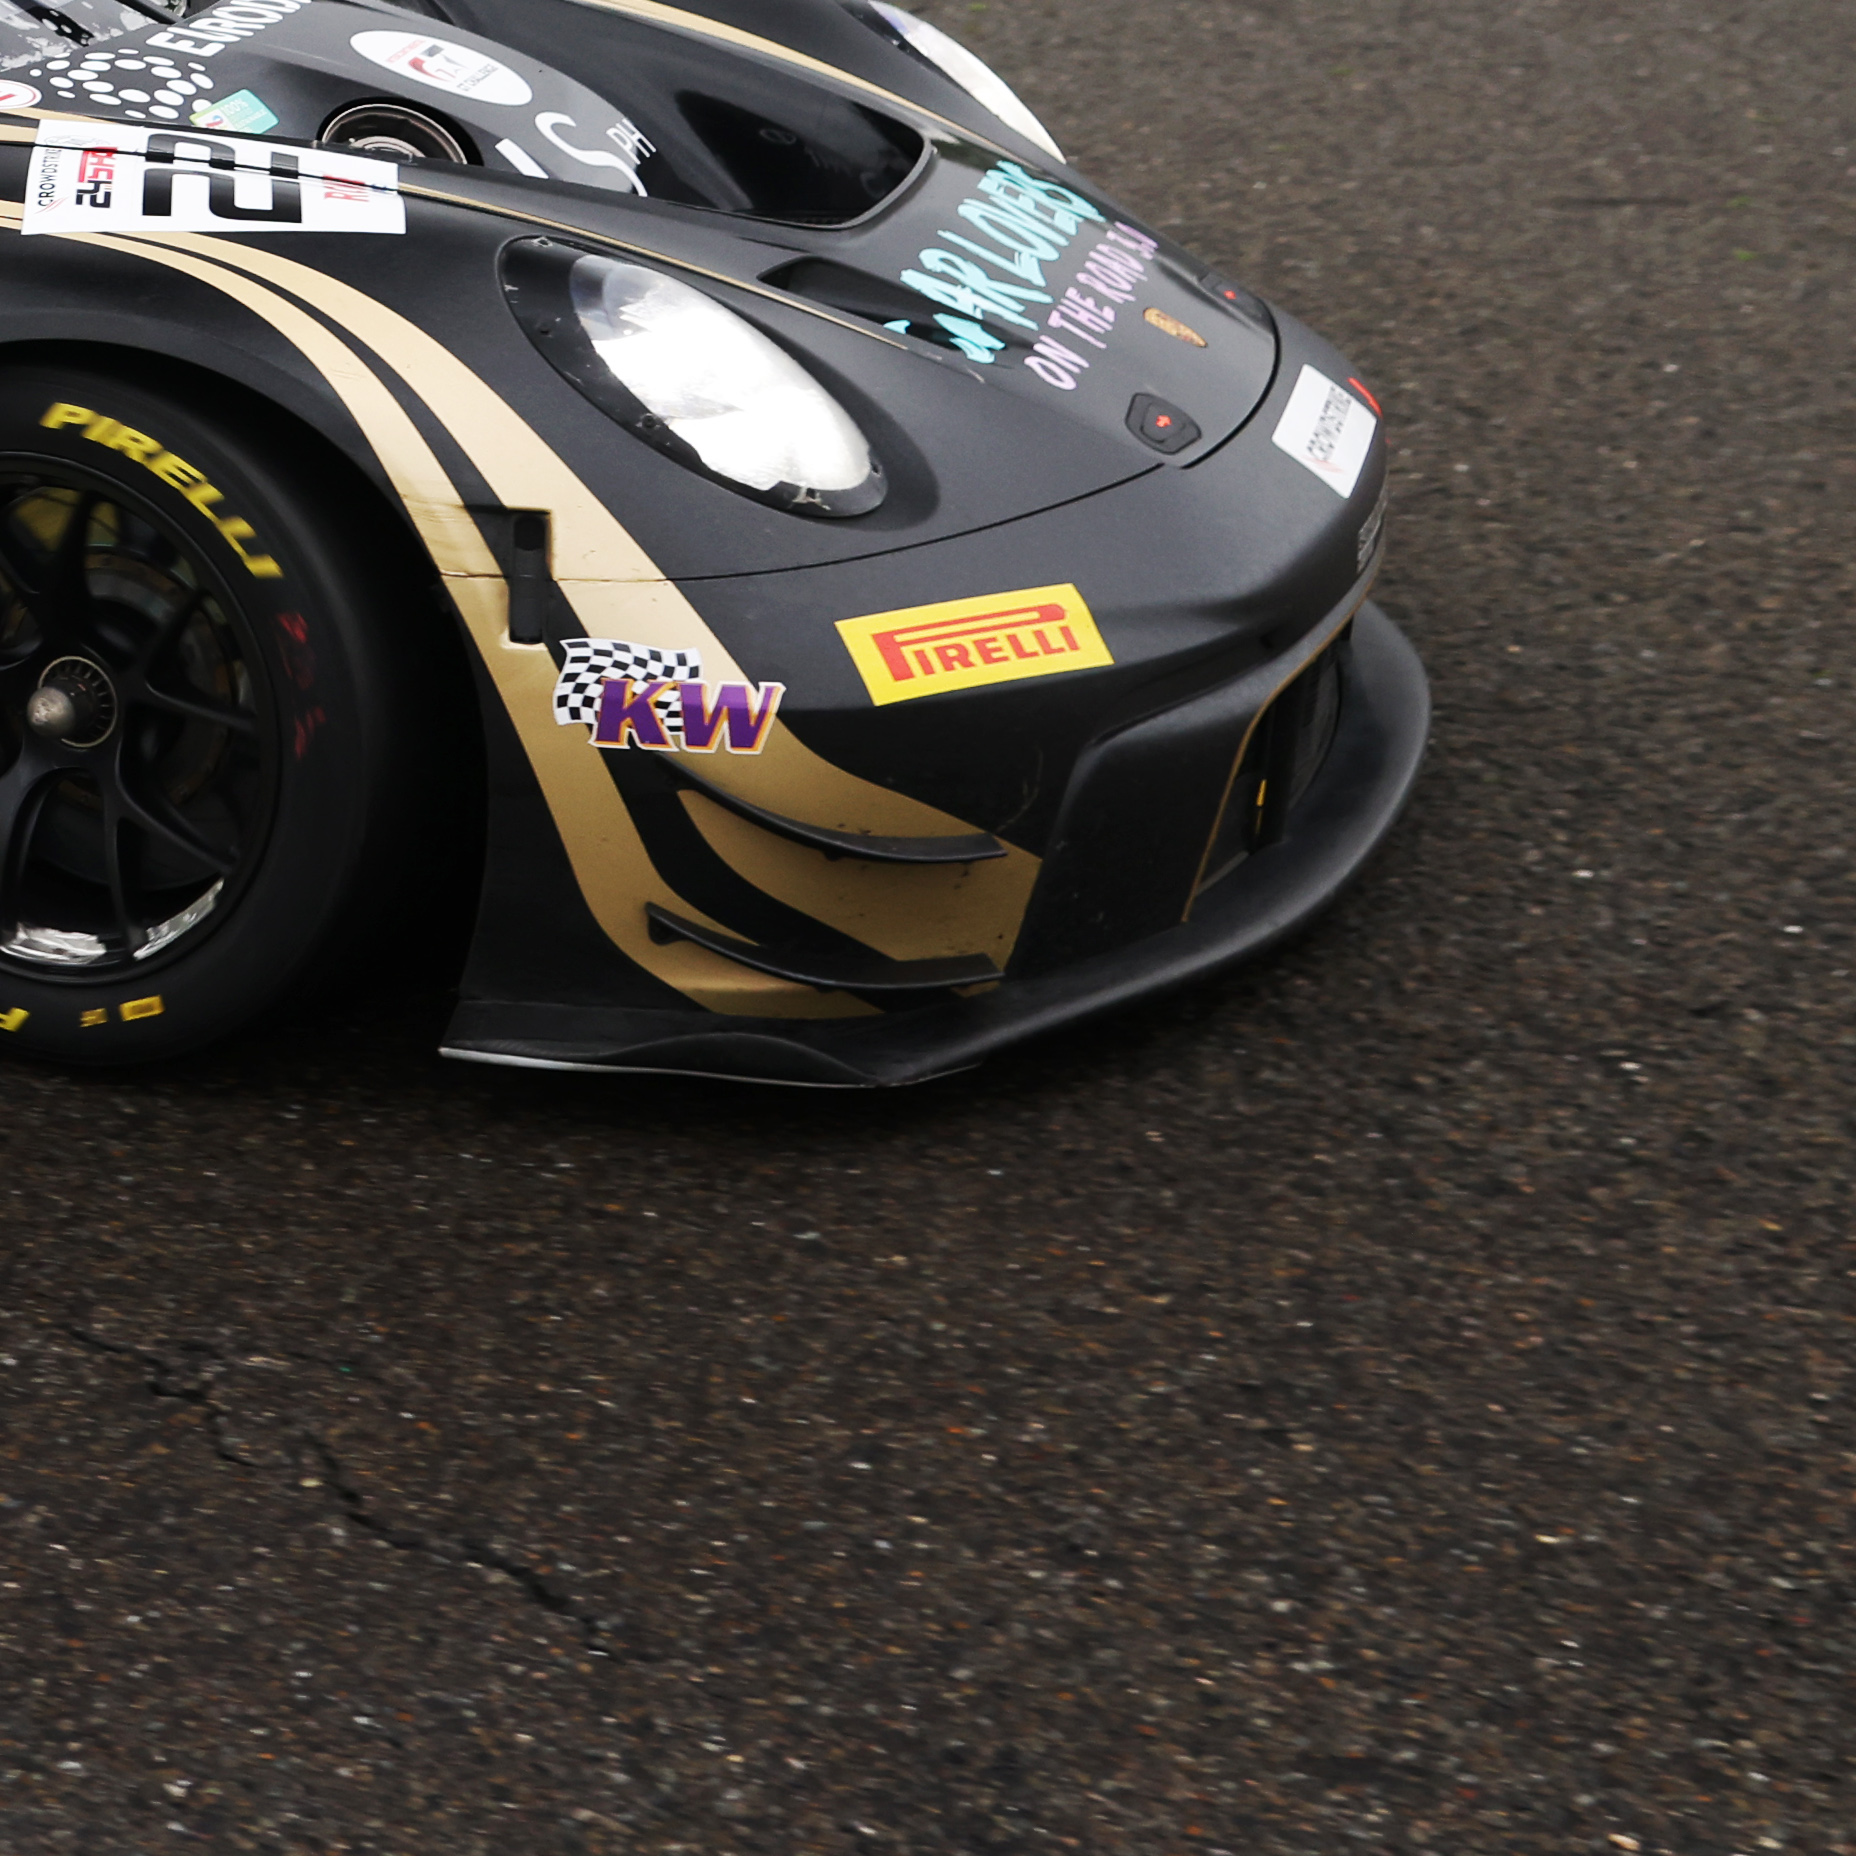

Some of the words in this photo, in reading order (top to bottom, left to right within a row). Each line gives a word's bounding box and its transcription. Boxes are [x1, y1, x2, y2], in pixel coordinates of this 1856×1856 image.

[1048, 287, 1116, 349] THE
[1024, 335, 1089, 390] ON
[39, 401, 284, 580] PIRELLI
[871, 603, 1081, 682] PIRELLI
[590, 677, 786, 754] KW
